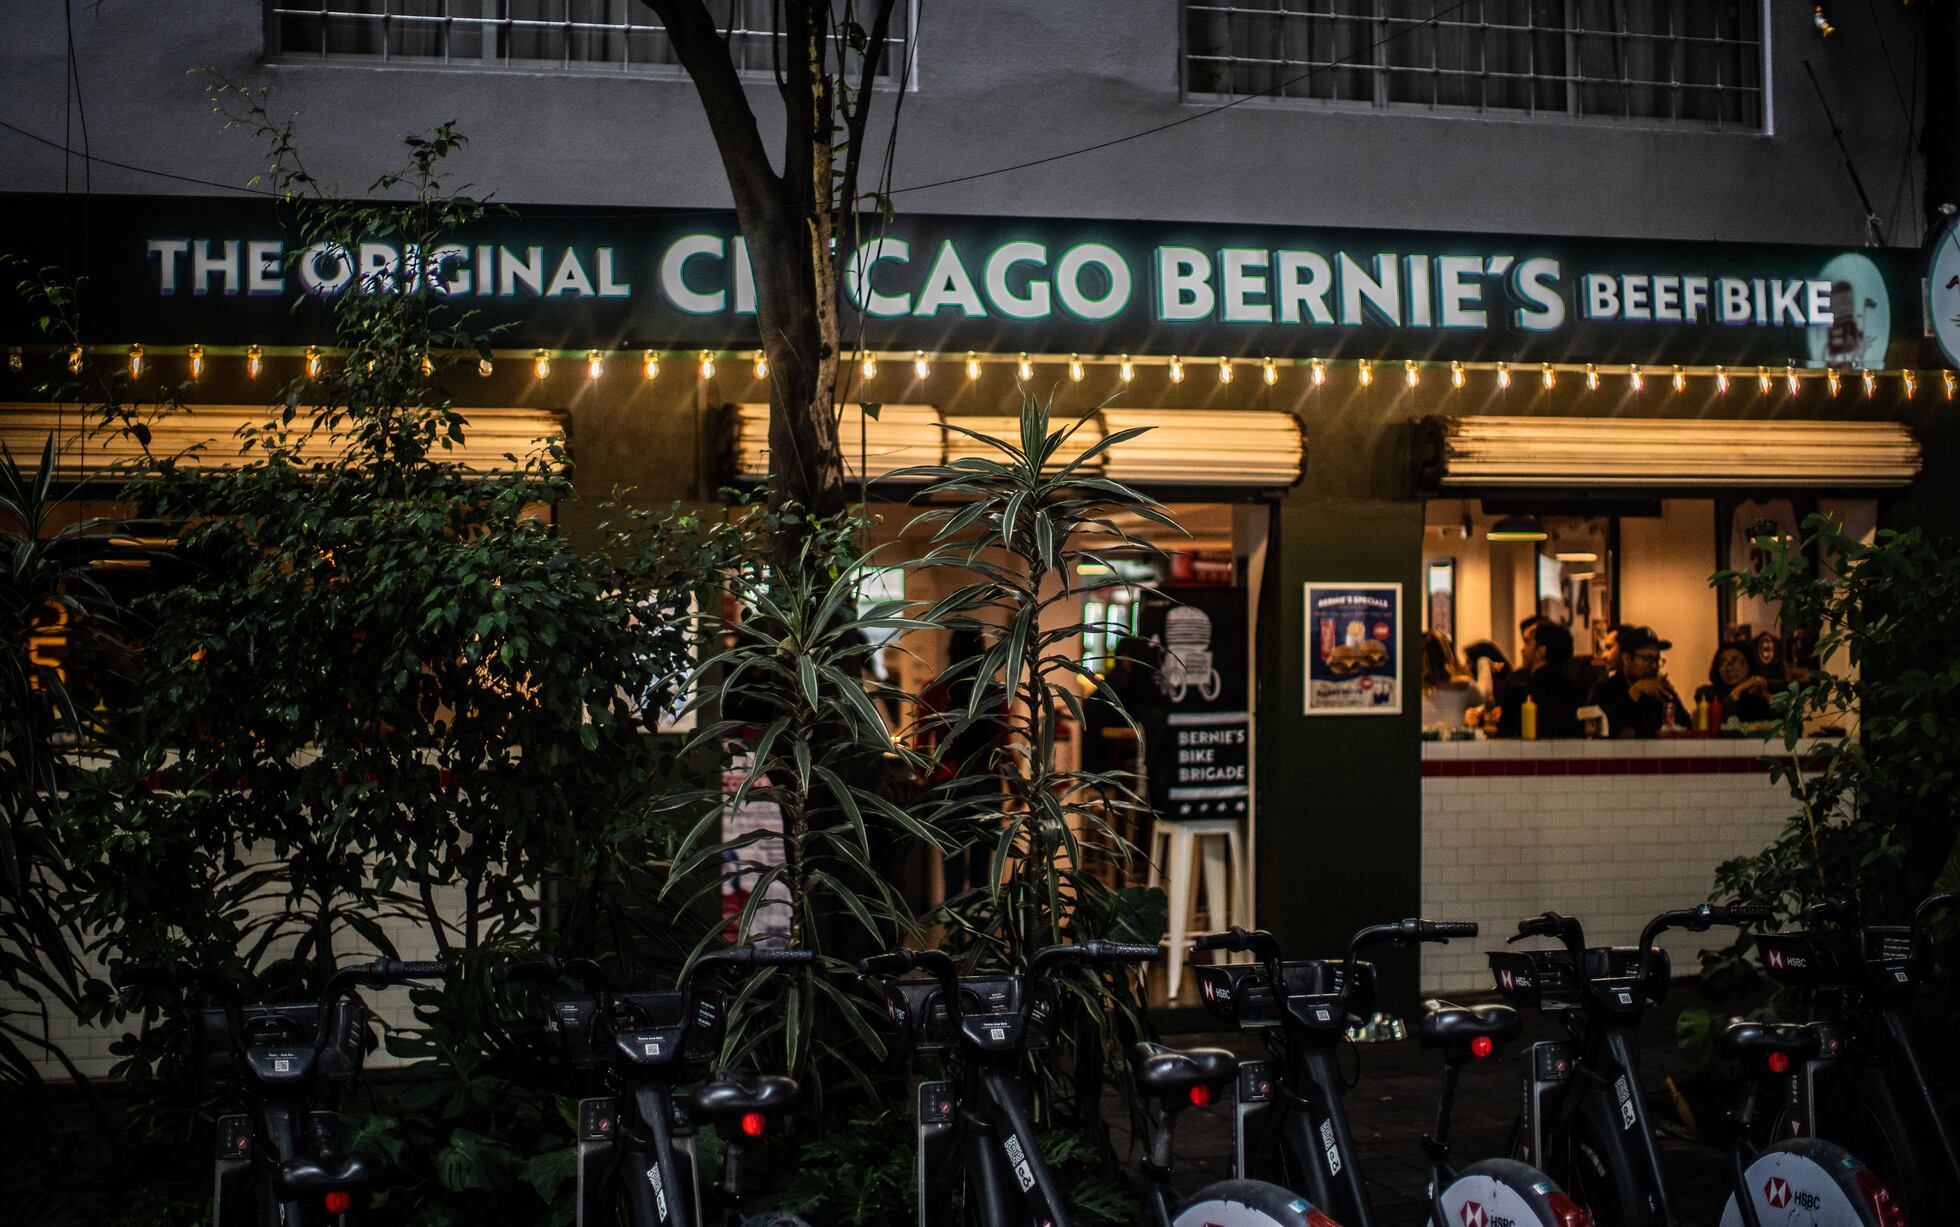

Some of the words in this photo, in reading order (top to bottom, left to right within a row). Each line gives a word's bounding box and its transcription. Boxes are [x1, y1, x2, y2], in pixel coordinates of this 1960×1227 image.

[147, 239, 286, 296] THE
[300, 240, 632, 297] ORIGINAL
[660, 233, 1132, 322] CCAGO
[1155, 245, 1566, 331] BERNIE'S
[1582, 273, 1708, 323] BEEF
[1716, 277, 1835, 327] BIKE
[1178, 729, 1245, 748] BERNIE'S
[1178, 748, 1215, 765] BIKE
[1178, 765, 1245, 783] BRIGADE
[1787, 956, 1807, 968] HSBC
[1794, 1191, 1821, 1210] HSBC
